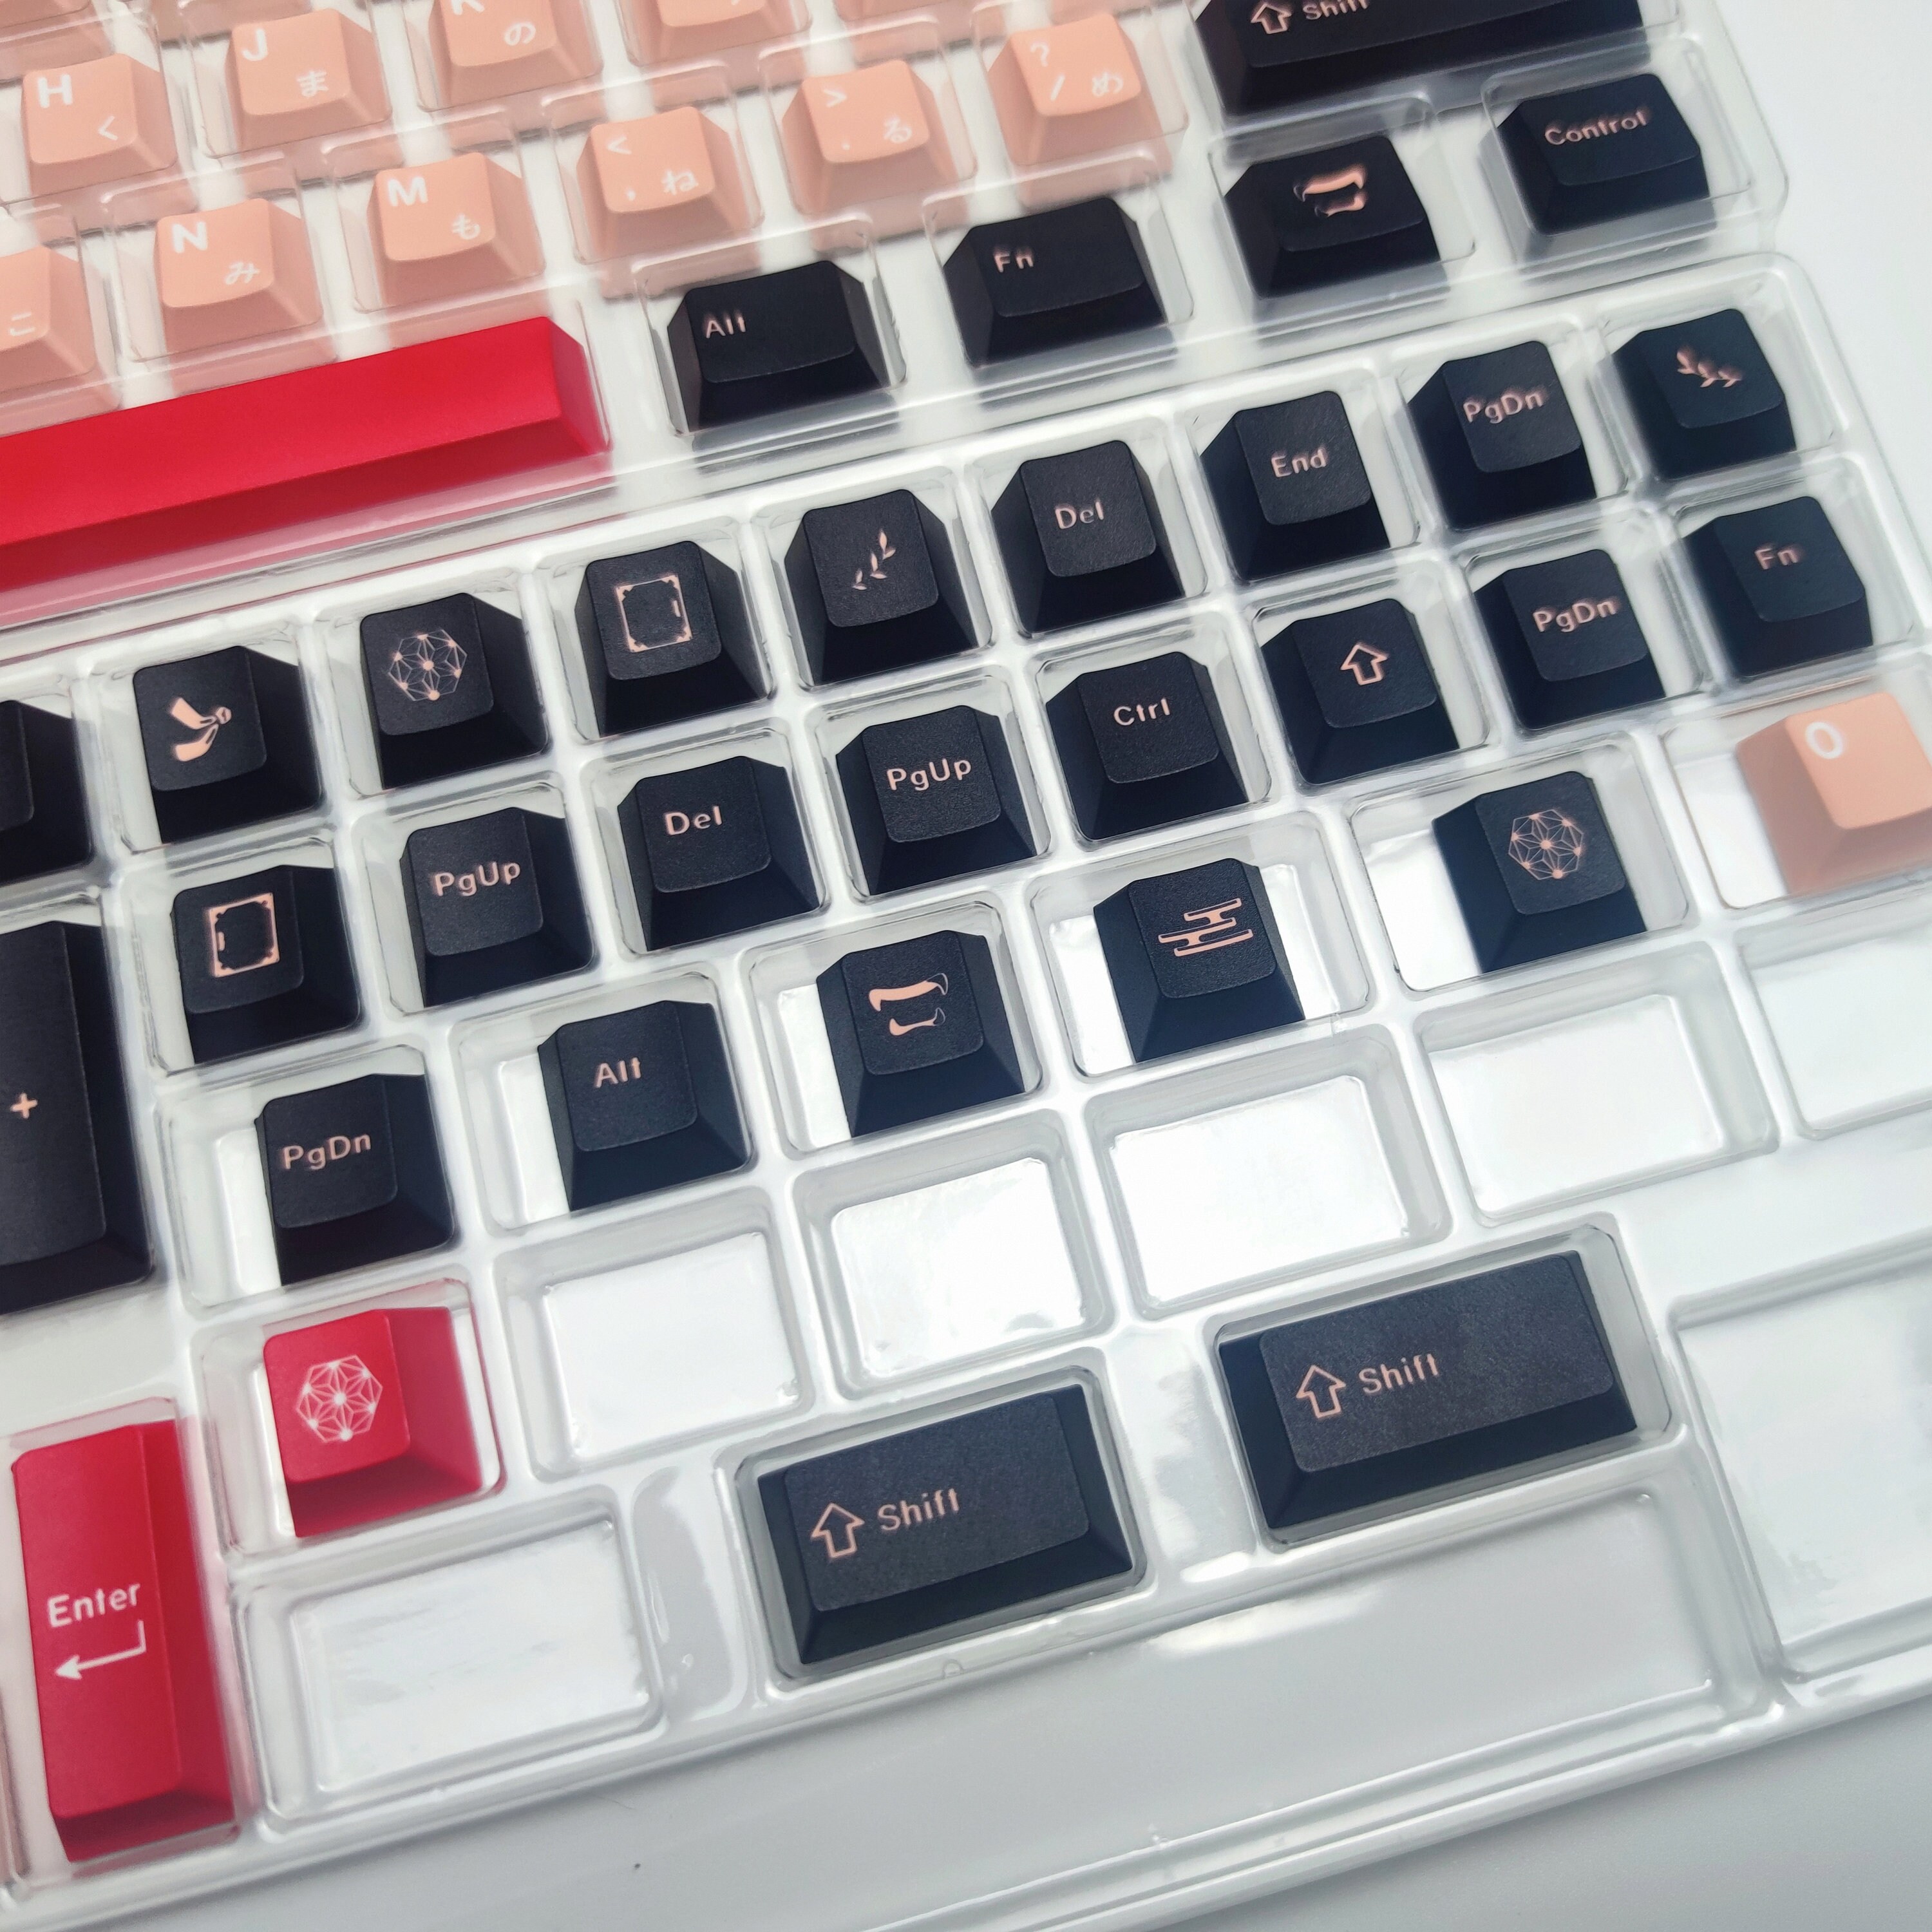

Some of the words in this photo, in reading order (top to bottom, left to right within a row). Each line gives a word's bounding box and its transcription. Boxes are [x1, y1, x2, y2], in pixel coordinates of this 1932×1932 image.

[242, 29, 267, 61] J
[504, 22, 536, 46] の
[1030, 43, 1048, 67] ?
[37, 73, 73, 108] H
[297, 71, 328, 97] ま
[823, 89, 846, 108] >
[1049, 76, 1065, 101] /
[1092, 72, 1123, 97] め
[884, 117, 912, 143] る
[1545, 109, 1647, 146] Control
[388, 177, 428, 207] M
[661, 169, 699, 195] ね
[171, 222, 207, 253] N
[452, 214, 480, 240] も
[225, 261, 260, 285] み
[994, 248, 1034, 272] Fn
[9, 312, 35, 336] こ
[1463, 389, 1545, 424] PgDn
[1271, 447, 1329, 478] End
[1055, 500, 1104, 529] Del
[1754, 544, 1801, 571] Fn
[1532, 598, 1618, 634] PgDn
[1113, 697, 1171, 726] Ctrl
[887, 758, 972, 791] PgUp
[667, 806, 723, 836] Del
[433, 861, 521, 896] PgUp
[593, 1056, 641, 1088] Alt
[282, 1132, 372, 1170] PgDn
[1359, 1353, 1439, 1394] Shift
[877, 1487, 960, 1531] Shift
[47, 1583, 141, 1628] Enter
